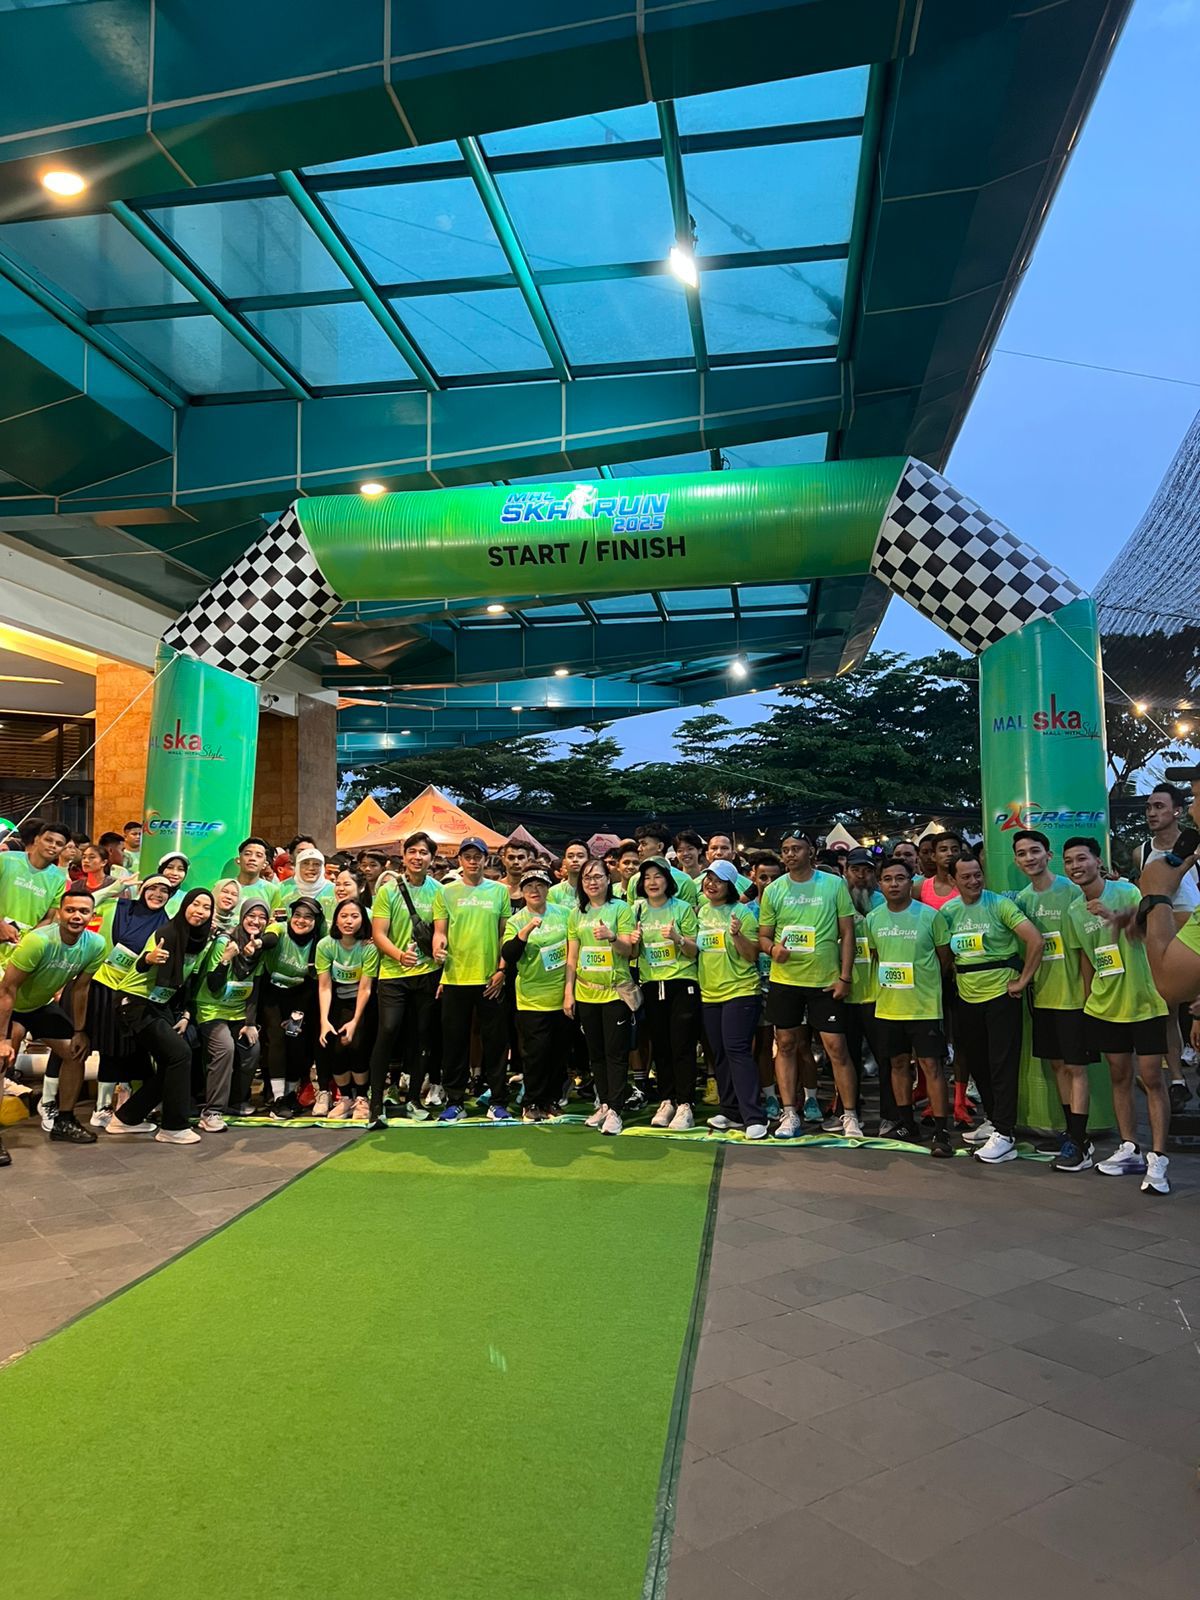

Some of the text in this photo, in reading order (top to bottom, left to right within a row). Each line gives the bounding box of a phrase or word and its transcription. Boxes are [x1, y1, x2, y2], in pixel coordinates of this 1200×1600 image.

[500, 493, 670, 525] SKA RUN
[612, 515, 666, 534] 2025
[488, 536, 686, 567] START / FINISH
[993, 694, 1082, 732] MAL ska
[163, 719, 202, 750] ska
[586, 953, 606, 963] 21054
[884, 970, 906, 981] 20931
